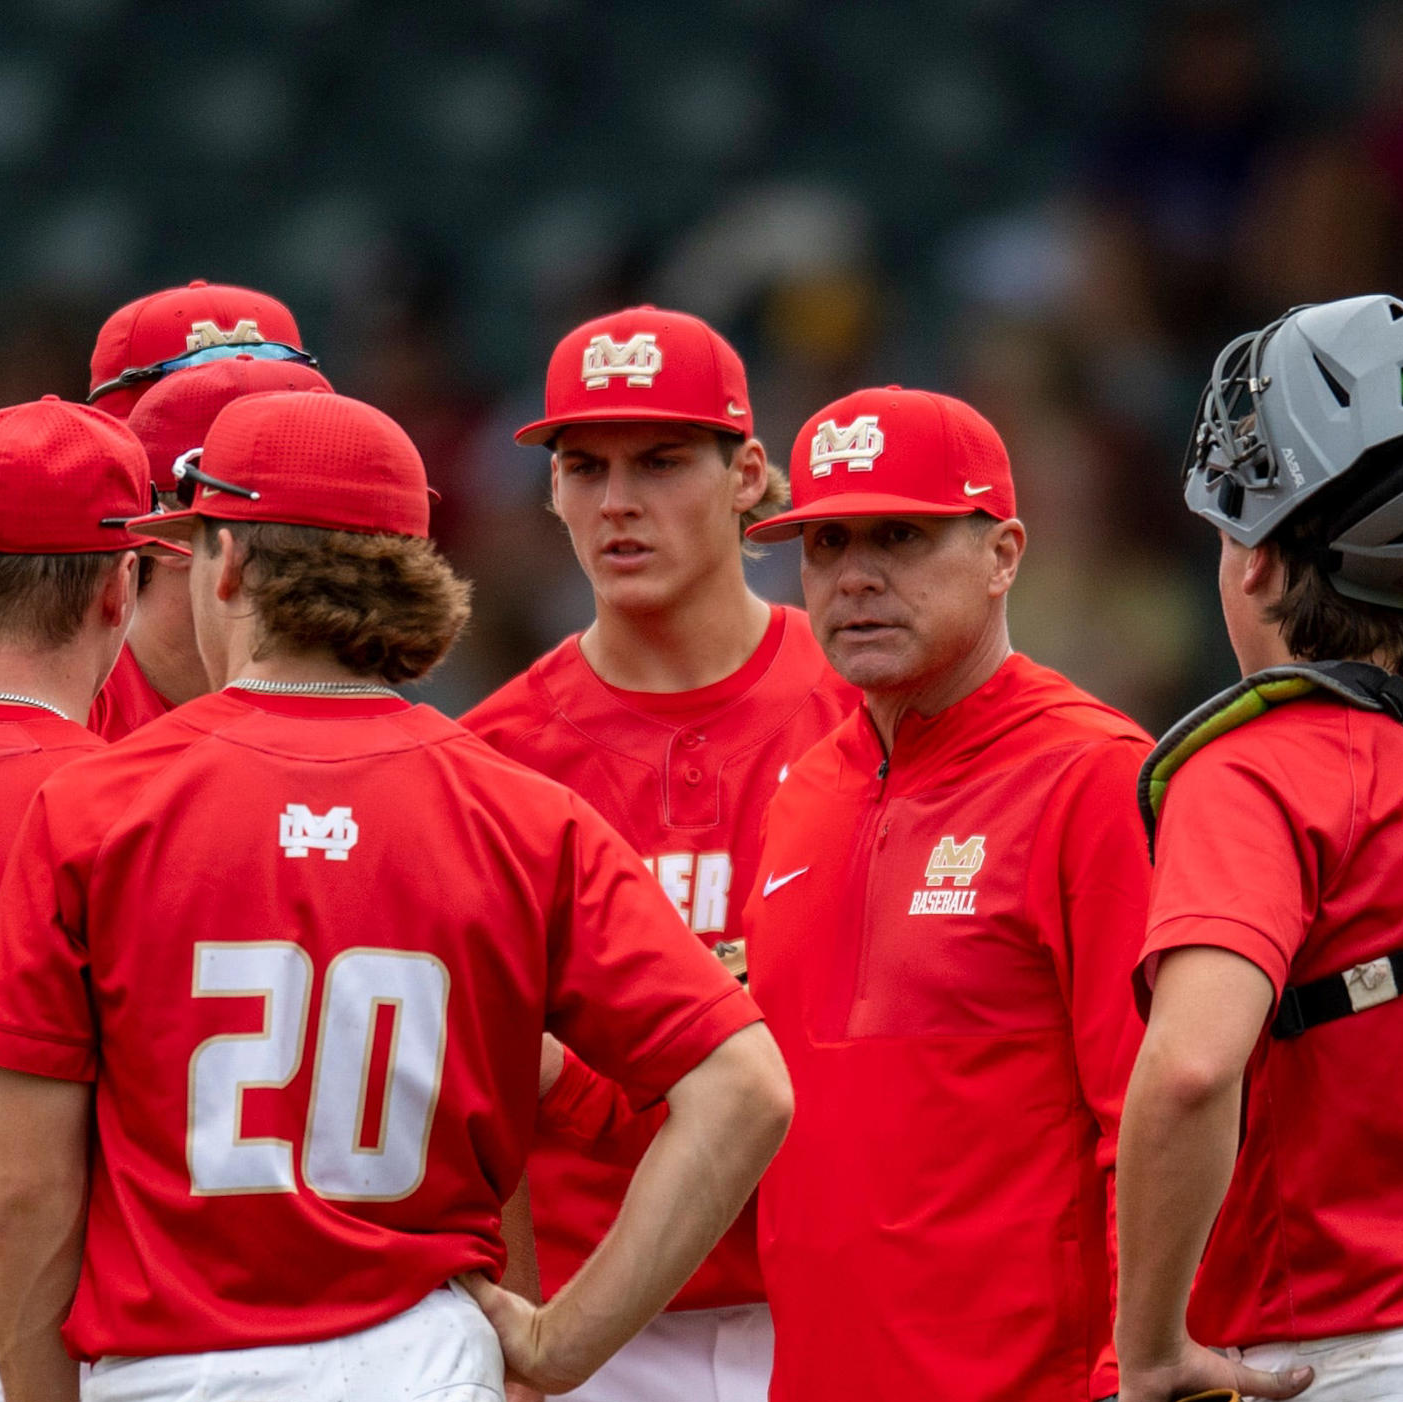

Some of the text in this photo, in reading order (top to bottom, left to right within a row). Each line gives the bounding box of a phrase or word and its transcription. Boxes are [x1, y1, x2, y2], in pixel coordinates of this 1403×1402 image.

[642, 852, 733, 935] ER
[908, 890, 977, 915] BASEBALL
[186, 940, 451, 1202] 20
